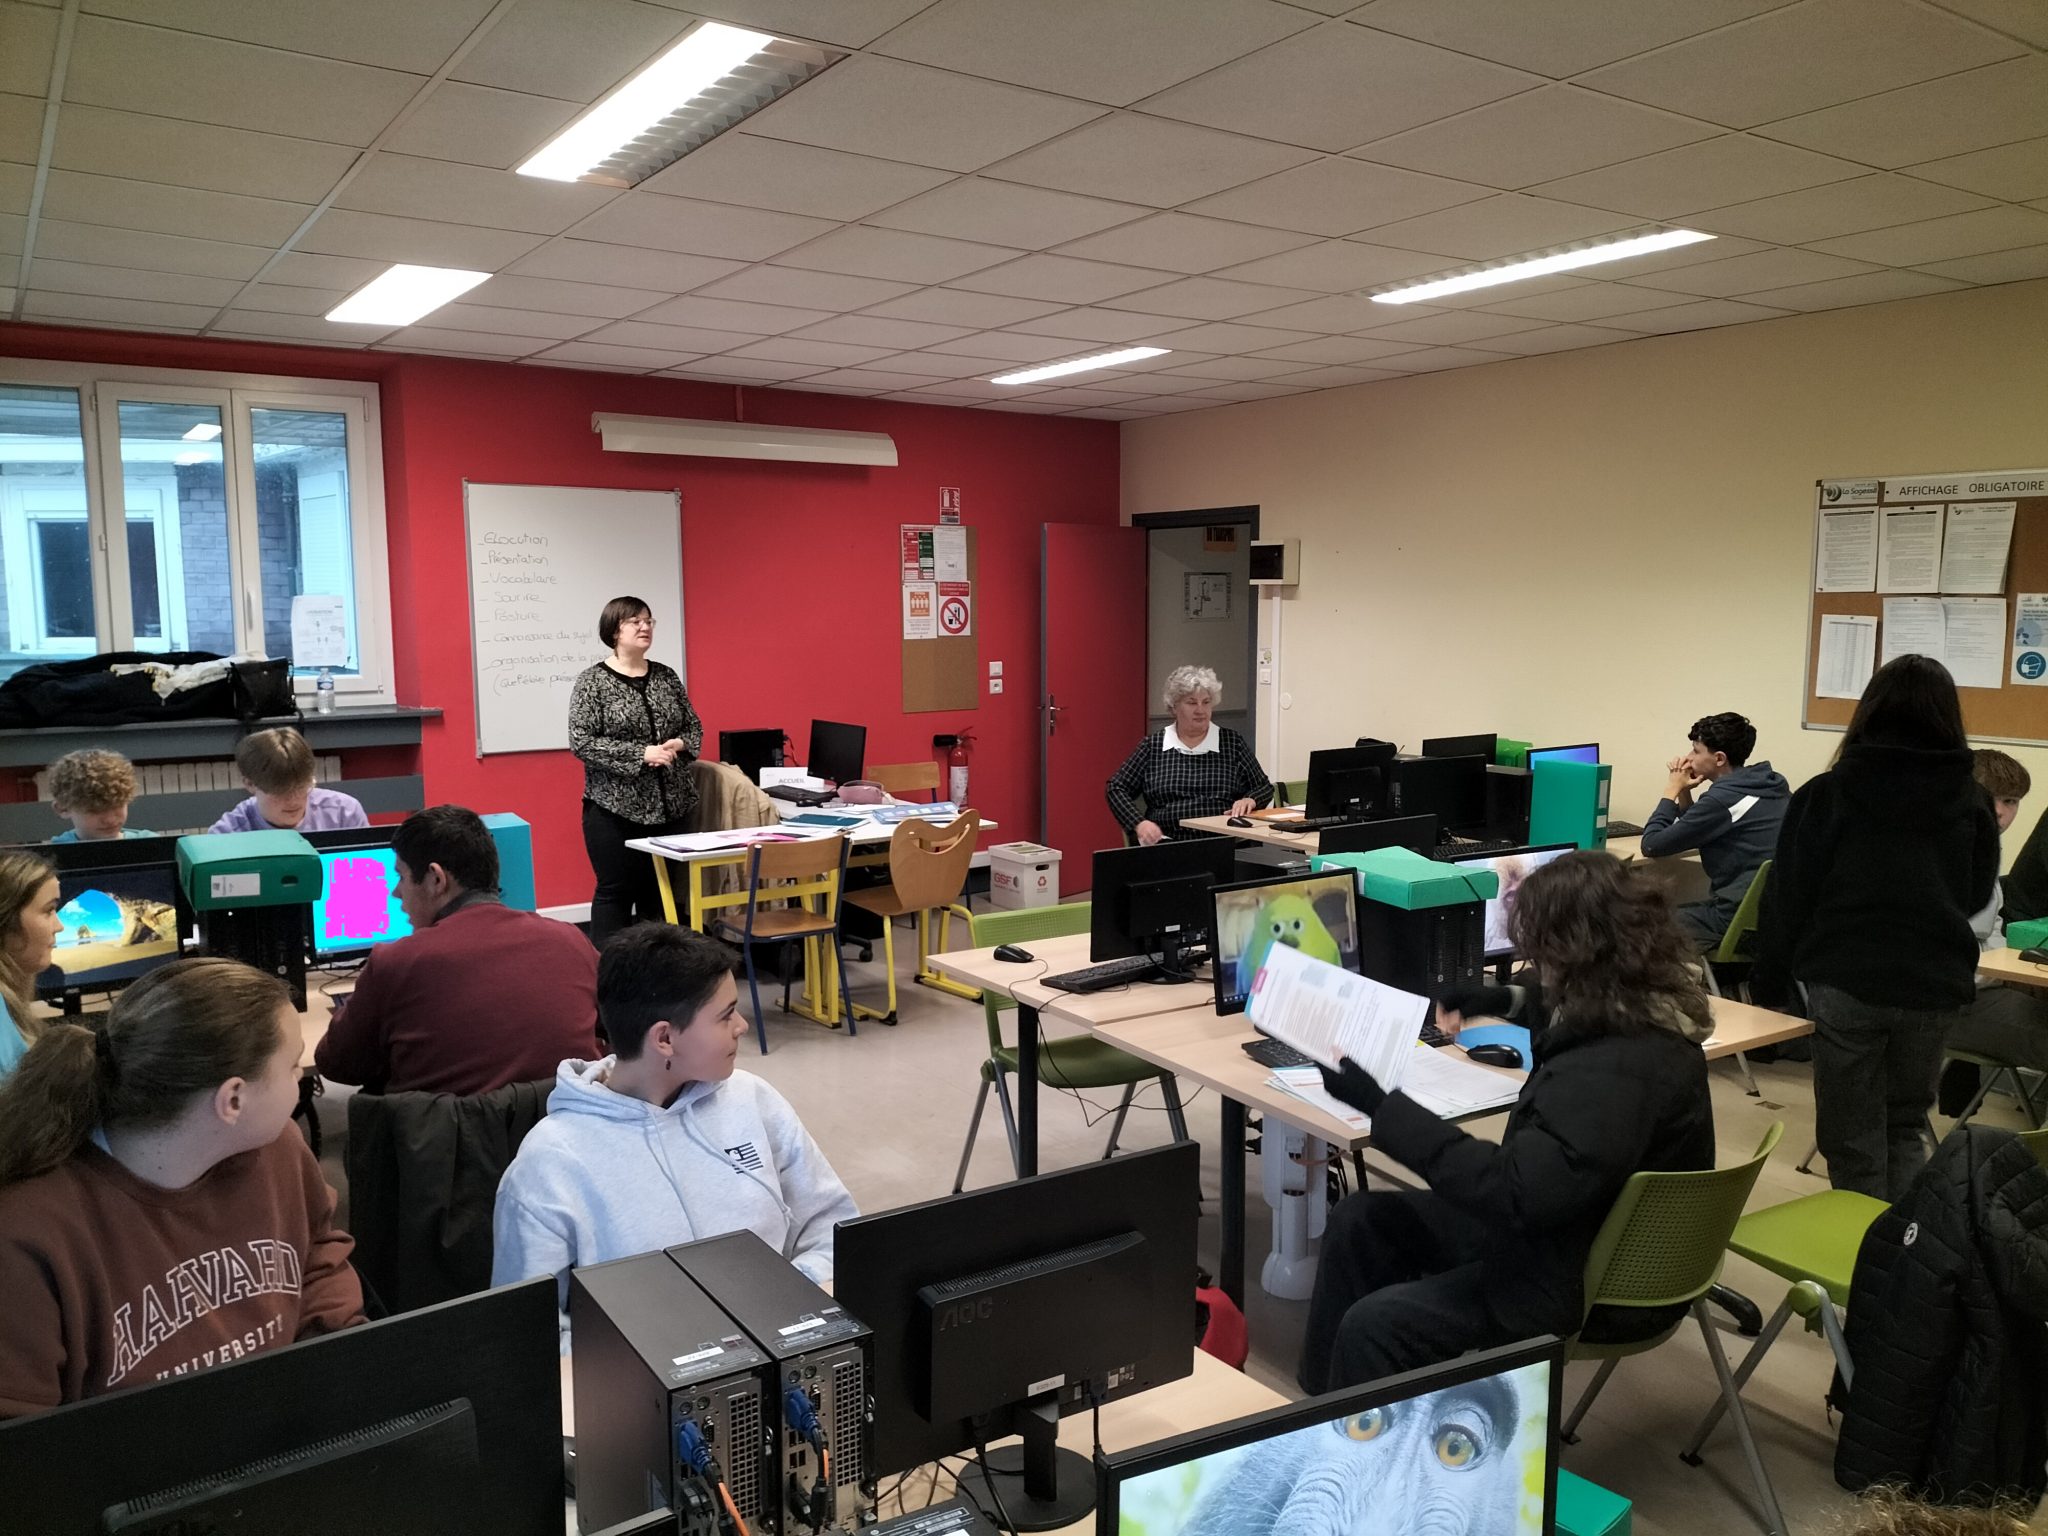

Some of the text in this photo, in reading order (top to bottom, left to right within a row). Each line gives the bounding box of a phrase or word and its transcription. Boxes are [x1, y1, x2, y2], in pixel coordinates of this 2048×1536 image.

[1899, 480, 2045, 496] AFFICHAGE OBLIGATOIRE
[994, 872, 1012, 885] GSF
